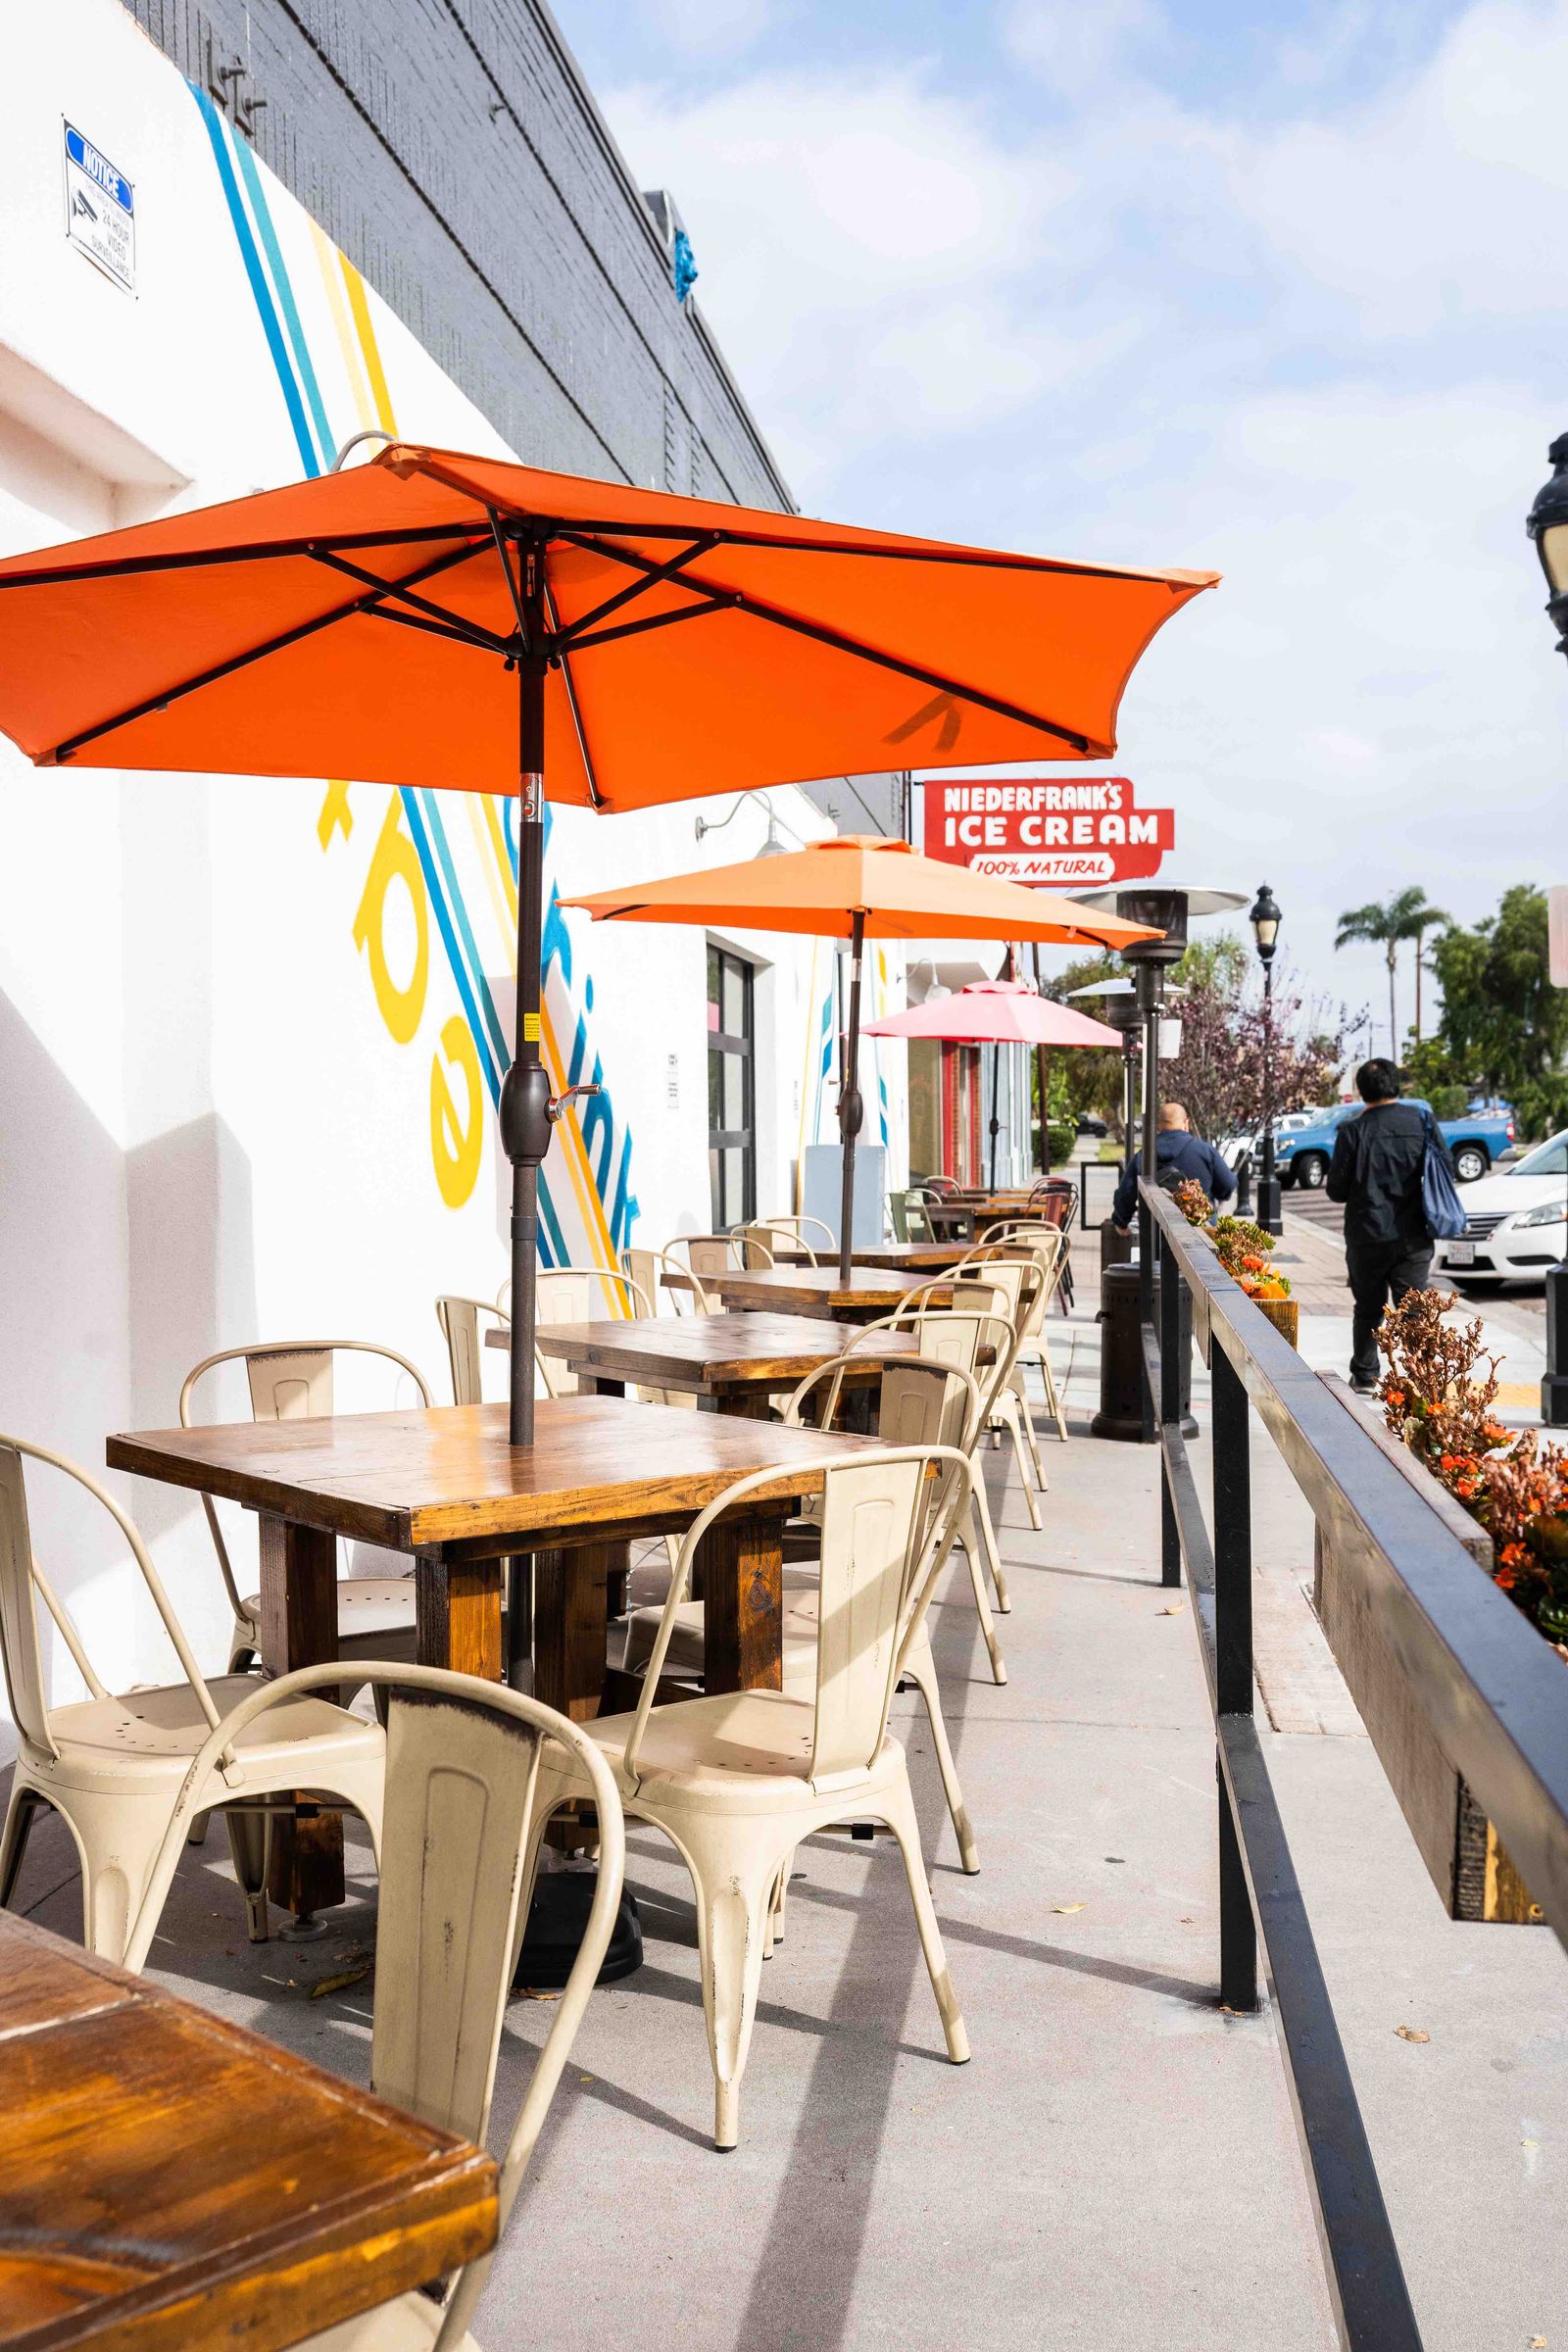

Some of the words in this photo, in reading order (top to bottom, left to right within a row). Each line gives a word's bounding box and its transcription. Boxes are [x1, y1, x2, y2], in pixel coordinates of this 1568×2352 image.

[82, 142, 120, 199] NOTICE
[103, 209, 111, 226] 24
[113, 220, 129, 243] HOUR
[91, 234, 129, 279] SURVEILLANCE
[108, 231, 126, 261] VIDEO
[945, 781, 1123, 812] NIEDERFRANK'S
[945, 815, 1007, 847] ICE
[1019, 814, 1158, 846] CREAM
[976, 860, 1020, 875] 100%
[1024, 859, 1106, 875] NATURAL
